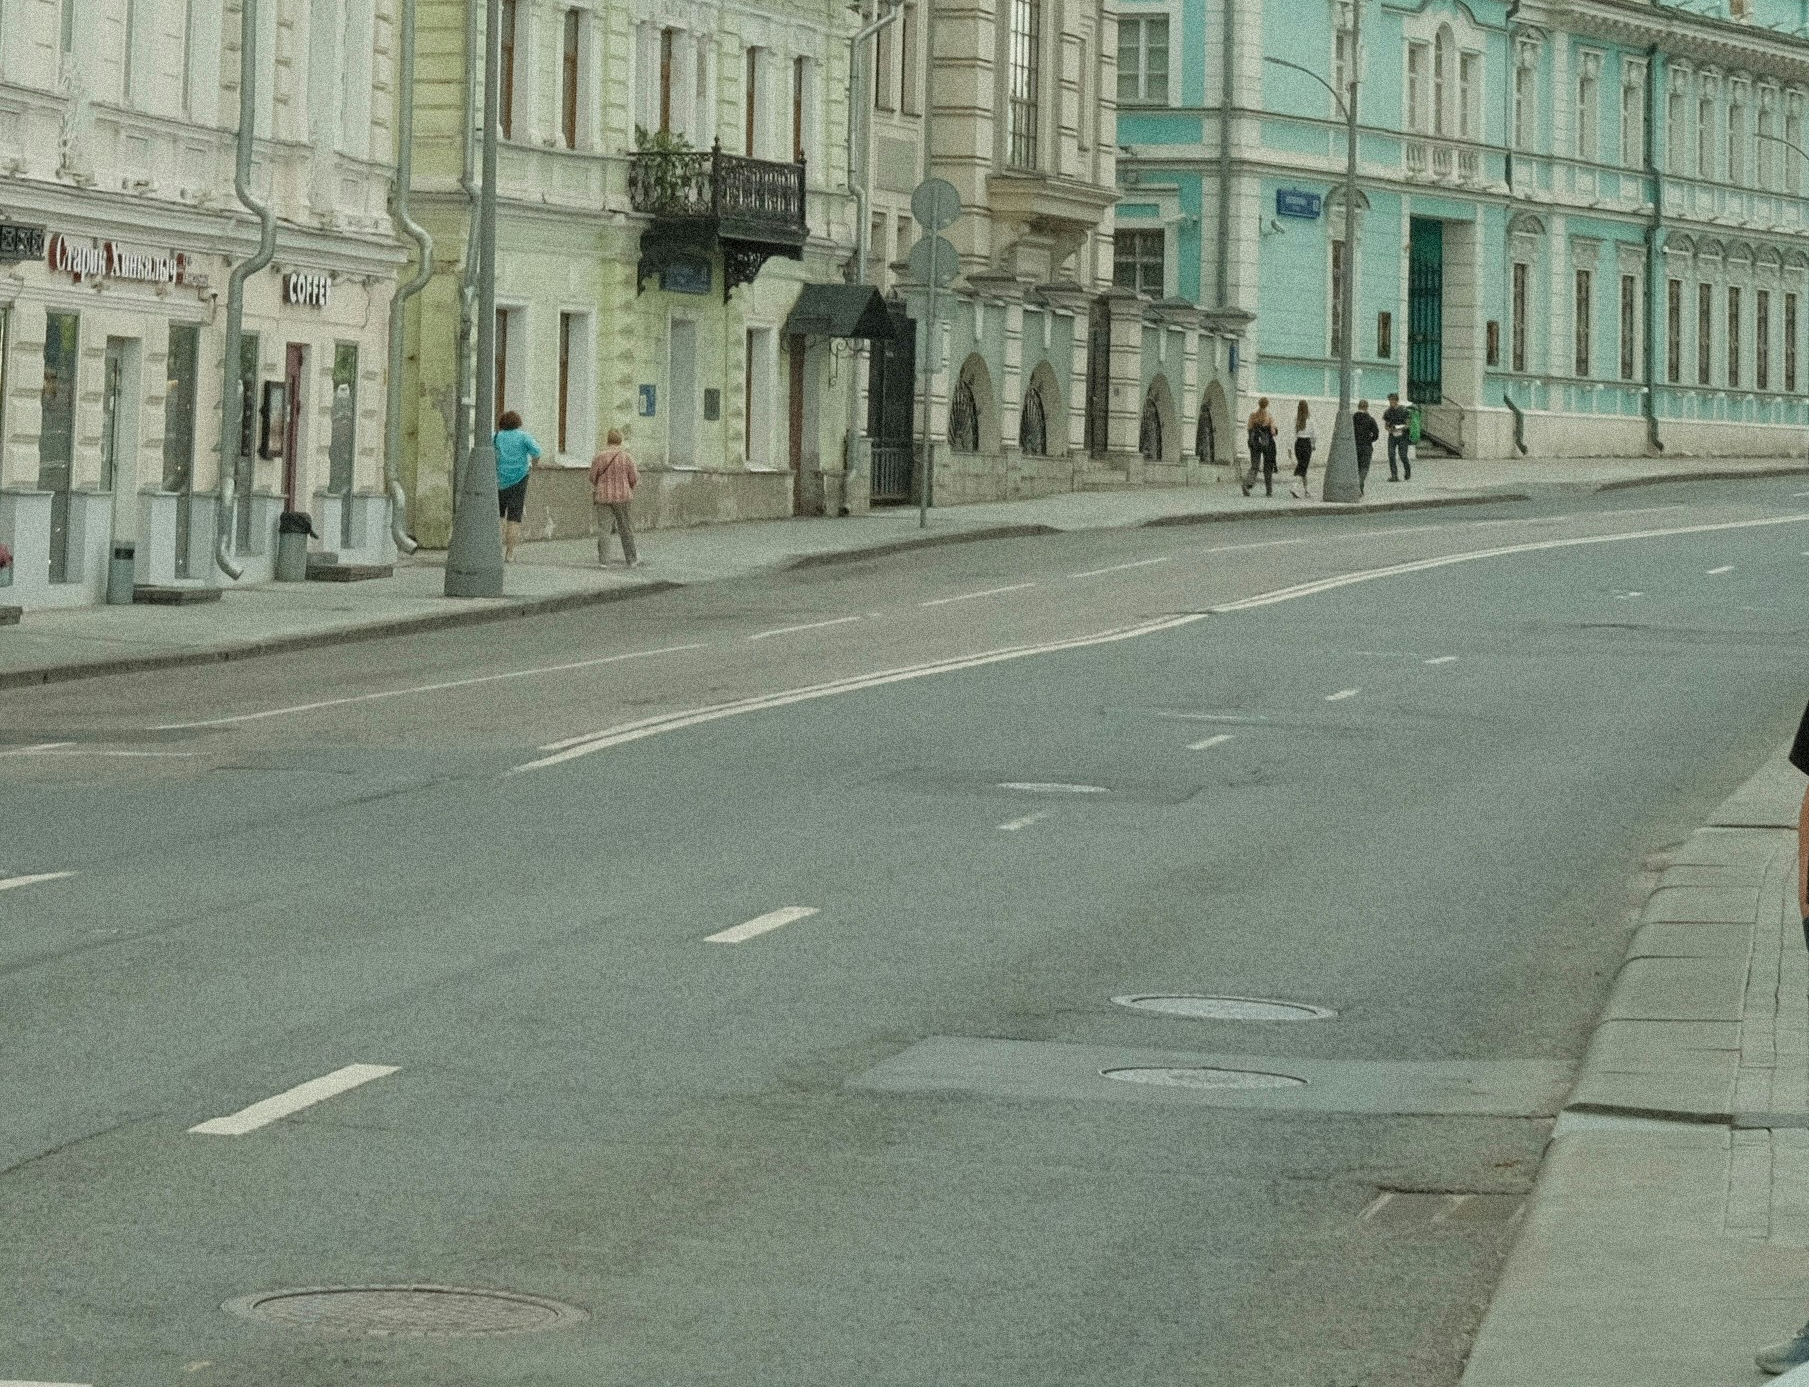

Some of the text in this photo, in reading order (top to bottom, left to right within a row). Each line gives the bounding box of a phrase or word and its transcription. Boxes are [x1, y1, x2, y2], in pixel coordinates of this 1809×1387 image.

[53, 233, 177, 283] Старик Хинкалыч
[288, 272, 332, 306] COFFEE
